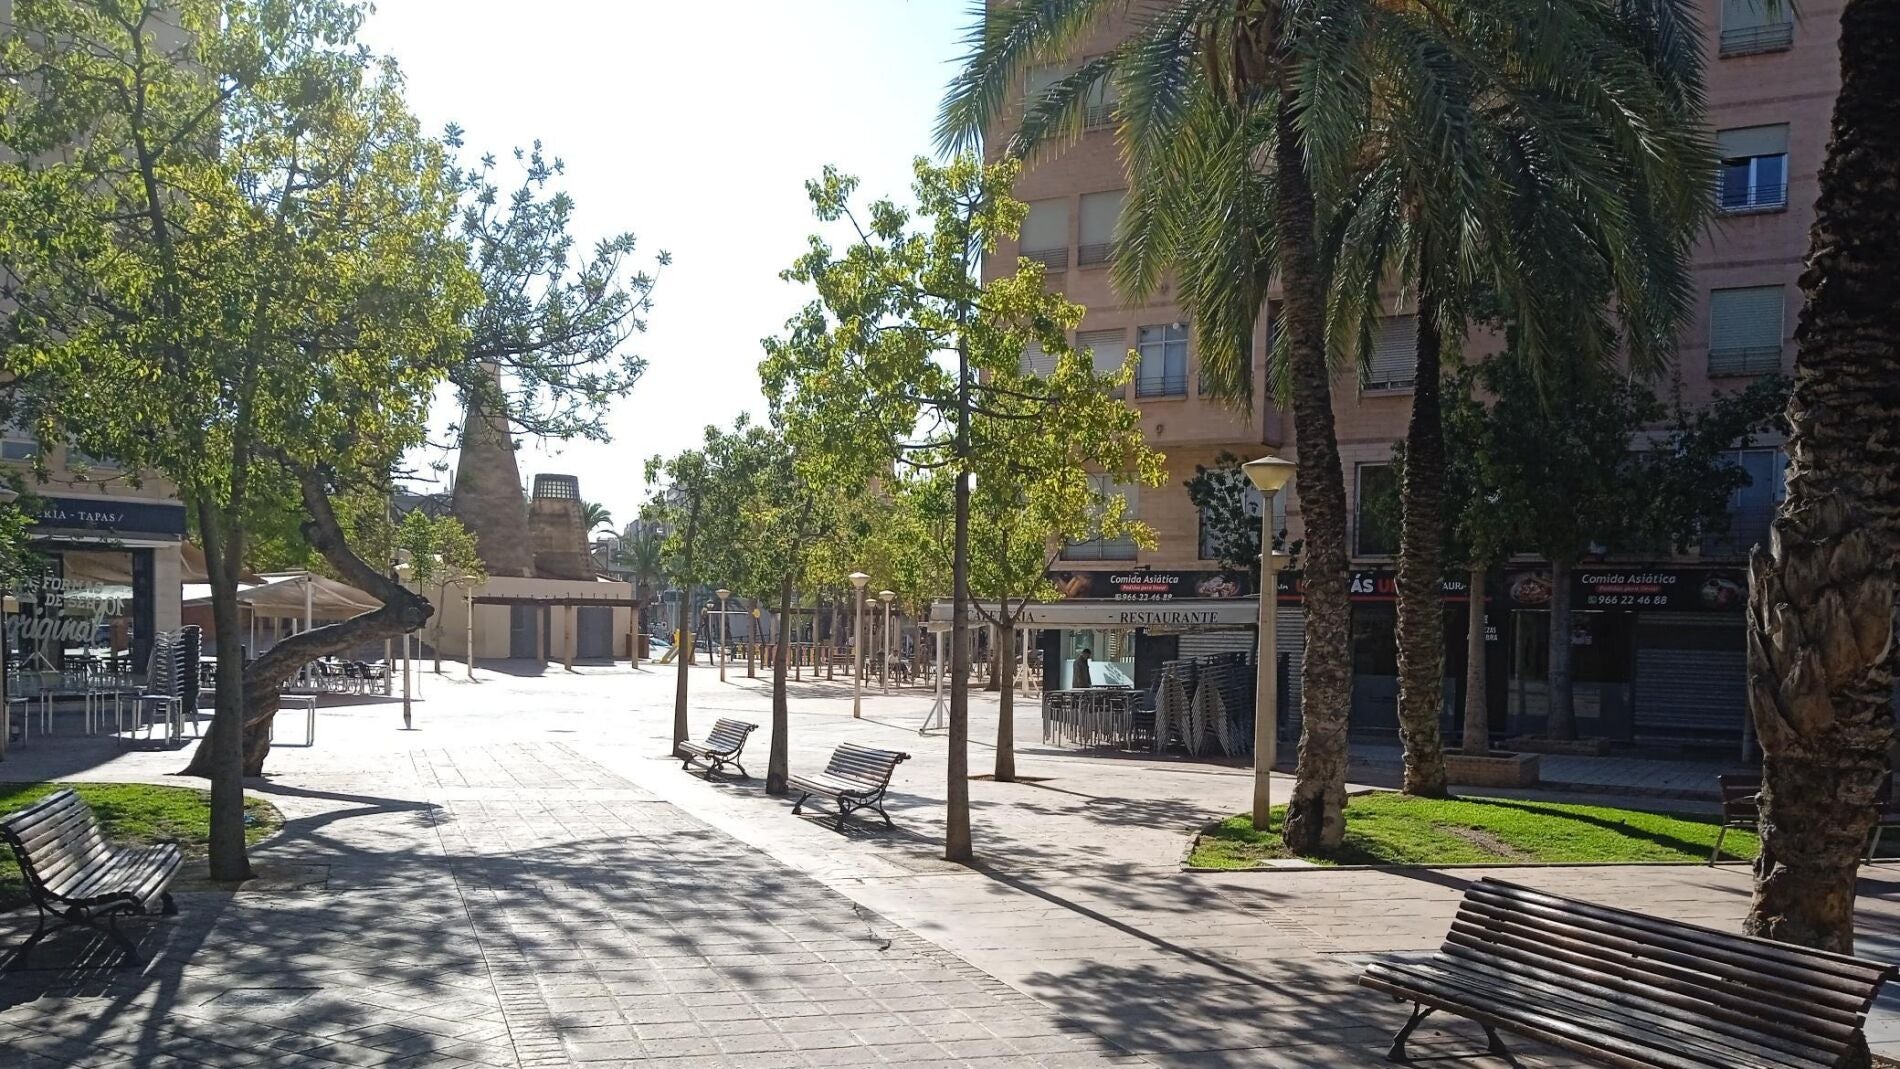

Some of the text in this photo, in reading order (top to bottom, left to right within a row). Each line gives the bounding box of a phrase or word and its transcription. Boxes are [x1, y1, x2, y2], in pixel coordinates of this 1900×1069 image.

[78, 511, 116, 522] TAPAS
[1110, 574, 1179, 584] Comida Asiática
[1350, 573, 1374, 593] ÁS
[1582, 573, 1676, 584] Comida Asiática
[42, 576, 104, 594] FORMAS
[45, 593, 63, 607] DE
[1122, 593, 1136, 601] 966
[1598, 595, 1618, 605] 966
[1621, 595, 1634, 605] 22
[1637, 595, 1651, 605] 46
[1120, 611, 1219, 623] RESTAURANTE
[6, 598, 108, 648] original
